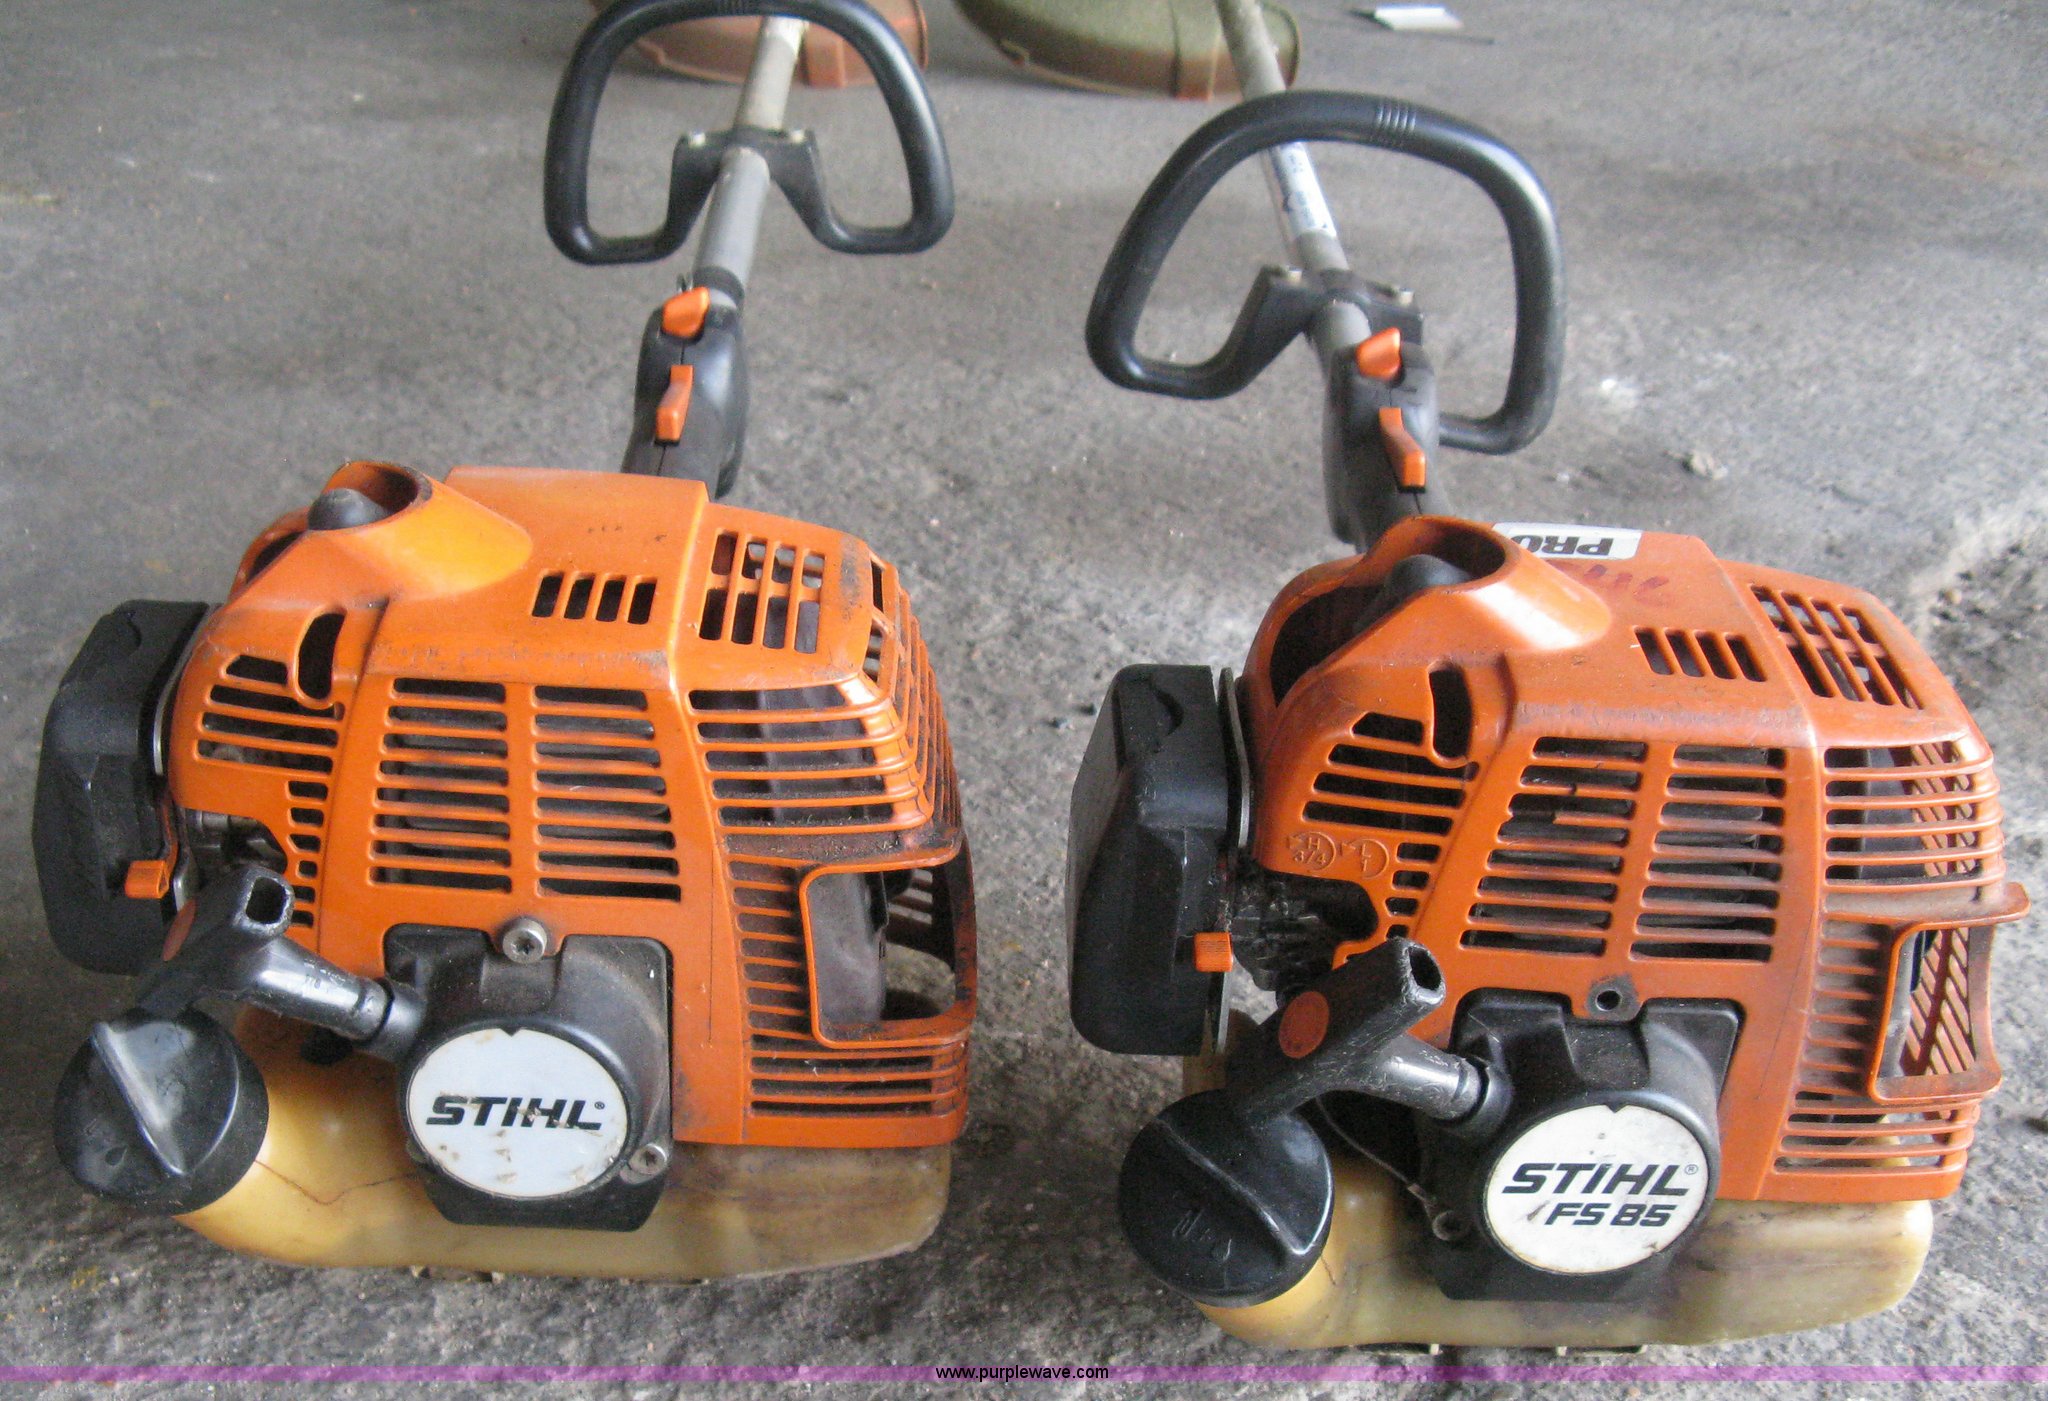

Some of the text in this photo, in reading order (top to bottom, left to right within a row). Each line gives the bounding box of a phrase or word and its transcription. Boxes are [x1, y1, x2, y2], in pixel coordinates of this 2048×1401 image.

[426, 1095, 603, 1131] STIHL
[1502, 1162, 1689, 1197] STIHL
[1544, 1202, 1677, 1227] FS 85
